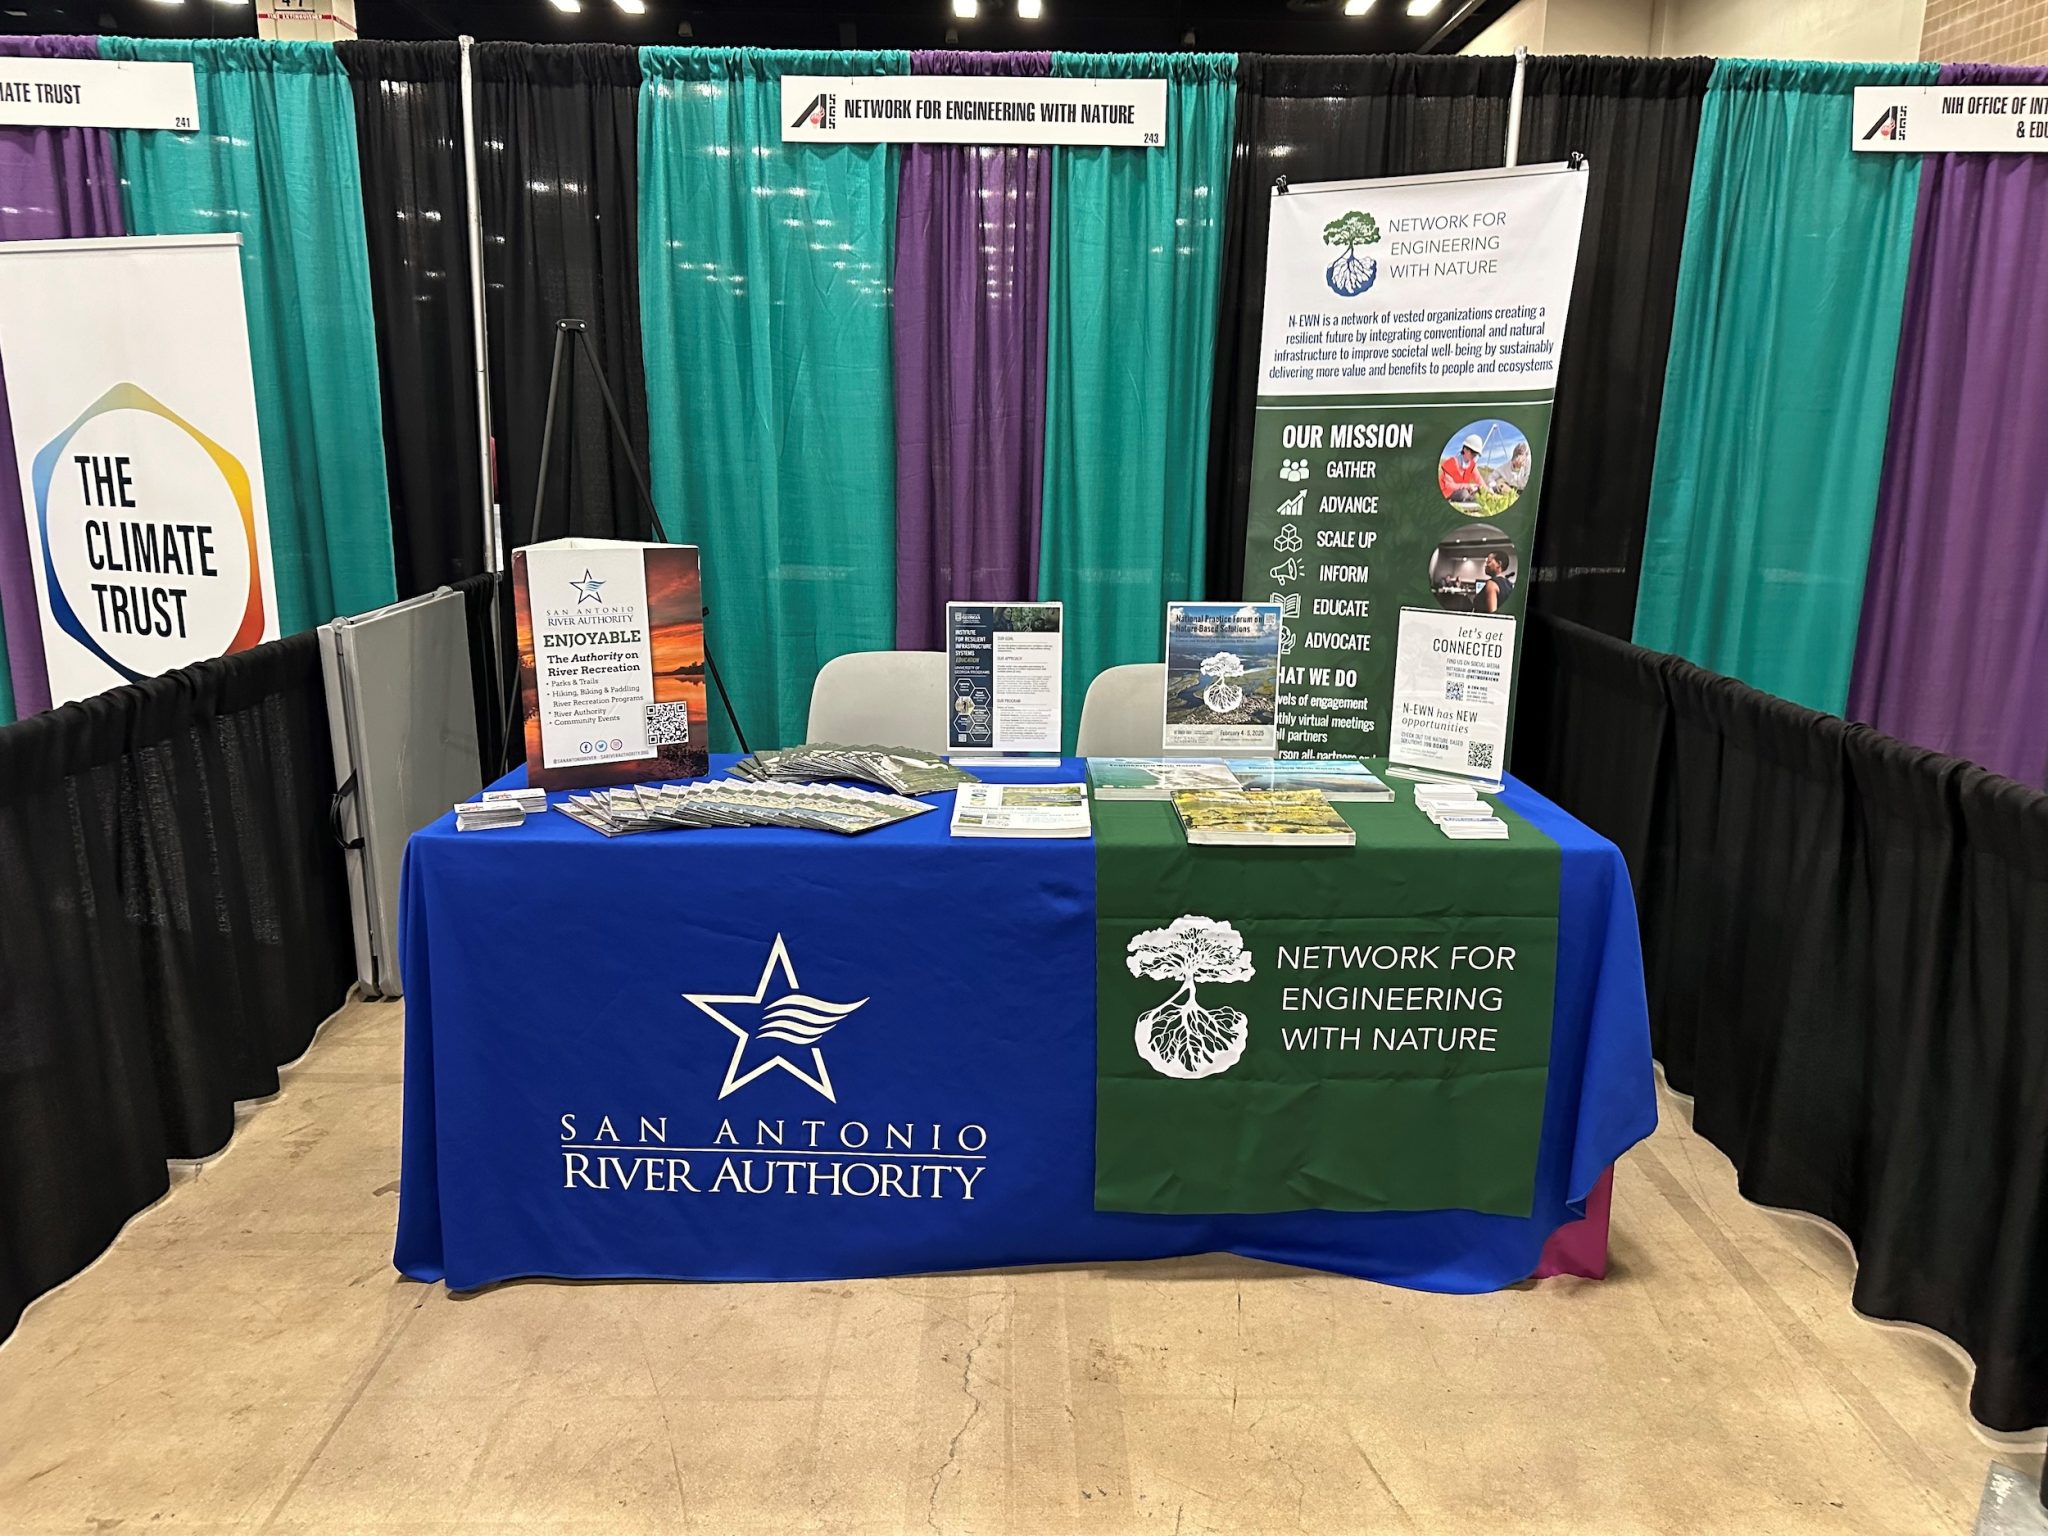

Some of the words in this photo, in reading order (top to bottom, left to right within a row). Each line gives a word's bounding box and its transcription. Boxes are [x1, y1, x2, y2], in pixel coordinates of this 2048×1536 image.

[35, 83, 81, 104] TRUST
[844, 99, 912, 118] NETWORK
[916, 100, 942, 119] FOR
[946, 100, 1035, 121] ENGINEERING
[1040, 102, 1076, 122] WITH
[1081, 104, 1135, 124] NATURE
[1942, 96, 1964, 114] NIH
[1967, 96, 2008, 114] OFFICE
[2011, 96, 2027, 114] OF
[175, 117, 191, 128] 241
[2016, 120, 2025, 138] &
[1144, 132, 1159, 143] 243
[1389, 214, 1469, 233] NETWORK
[1473, 211, 1506, 228] FOR
[1391, 235, 1500, 256] ENGINEERING
[1390, 262, 1430, 278] WITH
[1434, 259, 1498, 277] NATURE
[1322, 314, 1330, 326] is
[1332, 316, 1339, 326] a
[1341, 311, 1379, 325] network
[1381, 311, 1391, 324] of
[1393, 309, 1424, 323] vested
[1427, 307, 1493, 324] organizations
[1495, 305, 1537, 319] creating
[1539, 306, 1545, 317] a
[1286, 331, 1322, 344] resilient
[1325, 330, 1353, 343] future
[1356, 329, 1367, 344] by
[1369, 327, 1421, 343] integrating
[1424, 324, 1486, 340] conventional
[1488, 323, 1507, 337] and
[1510, 321, 1545, 336] natural
[1274, 347, 1337, 361] infrastructure
[1340, 347, 1349, 360] to
[1351, 347, 1389, 362] improve
[1392, 344, 1428, 358] societal
[1485, 342, 1496, 357] by
[1499, 339, 1554, 354] sustainably
[1269, 366, 1314, 380] delivering
[1316, 368, 1339, 378] more
[1342, 364, 1366, 377] value
[1368, 363, 1386, 376] and
[1388, 362, 1427, 376] benefits
[1429, 362, 1439, 375] to
[1442, 360, 1474, 376] people
[1477, 359, 1495, 373] and
[1498, 359, 1553, 374] ecosystems
[1282, 424, 1323, 449] OUR
[1330, 423, 1413, 449] MISSION
[1326, 461, 1376, 479] GATHER
[74, 455, 136, 508] THE
[1319, 496, 1379, 514] ADVANCE
[85, 519, 218, 577] CLIMATE
[1316, 530, 1356, 548] SCALE
[1358, 531, 1377, 548] UP
[1319, 565, 1369, 583] INFORM
[91, 583, 187, 639] TRUST
[547, 608, 568, 616] SAN
[577, 606, 634, 615] ANTONIO
[1313, 598, 1369, 618] EDUCATE
[548, 616, 576, 627] RIVER
[577, 614, 633, 625] AUTHORITY
[1176, 614, 1204, 623] National
[1205, 615, 1231, 623] Practice
[1233, 614, 1253, 623] Forum
[1220, 624, 1250, 633] Solutions
[1458, 626, 1482, 639] let's
[1485, 631, 1504, 643] get
[543, 630, 641, 648] ENJOYABLE
[1304, 633, 1371, 652] ADVOCATE
[547, 655, 569, 664] The
[571, 651, 623, 662] Authority
[625, 652, 639, 660] on
[1433, 638, 1503, 659] CONNECTED
[548, 667, 578, 677] River
[581, 663, 640, 675] Recreation
[1278, 666, 1305, 685] HAT
[1309, 667, 1331, 687] WE
[1334, 669, 1357, 688] DO
[551, 680, 571, 688] Parks
[580, 689, 602, 697] Biking
[611, 685, 640, 695] Paddling
[553, 700, 572, 708] River
[573, 697, 610, 707] Recreation
[611, 694, 644, 705] Programs
[1278, 693, 1296, 706] vels
[1298, 694, 1309, 707] of
[1310, 697, 1368, 711] engagement
[554, 710, 572, 718] River
[573, 707, 606, 717] Authority
[554, 717, 596, 726] Community
[597, 714, 620, 723] Events
[1403, 702, 1434, 717] N-EWN
[1436, 708, 1453, 720] has
[1456, 710, 1478, 723] NEW
[1299, 713, 1329, 727] virtual
[1331, 716, 1375, 732] meetings
[1402, 716, 1469, 734] opportunities
[1288, 730, 1328, 743] partners
[1277, 945, 1440, 970] NETWORK
[1450, 945, 1517, 971] FOR
[1282, 986, 1503, 1012] ENGINEERING
[1281, 1026, 1361, 1051] WITH
[1373, 1027, 1498, 1052] NATURE
[560, 1113, 668, 1142] SAN
[713, 1118, 987, 1152] ANTONIO
[562, 1151, 701, 1193] RIVER
[708, 1156, 987, 1200] AUTHORITY
